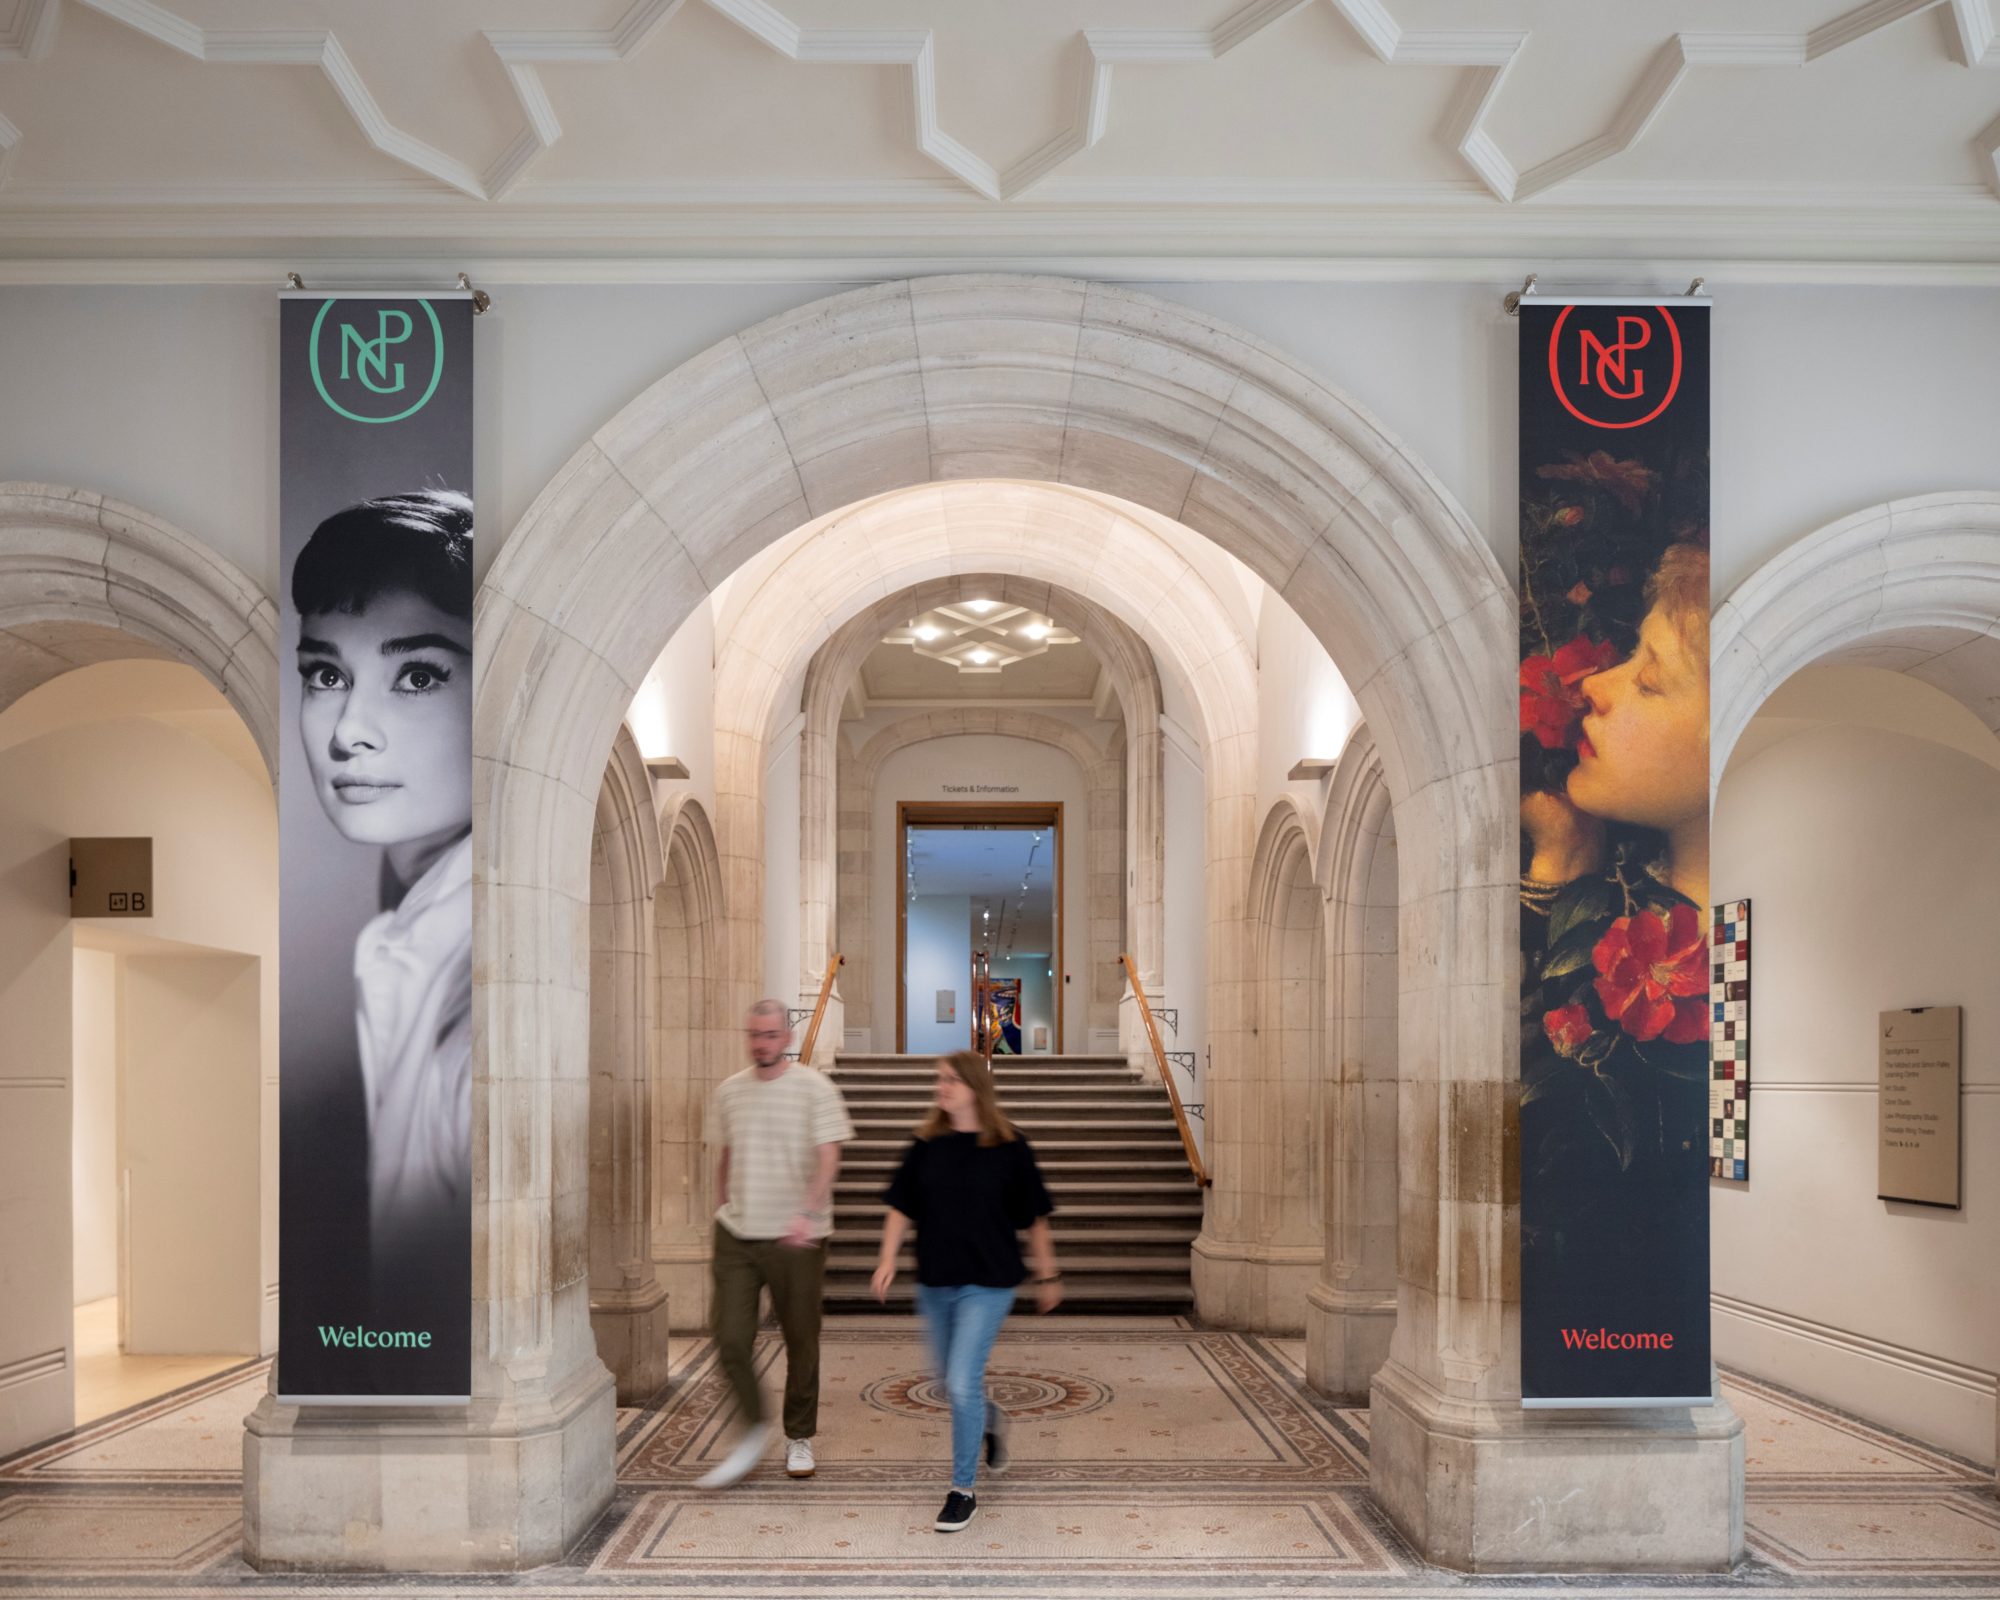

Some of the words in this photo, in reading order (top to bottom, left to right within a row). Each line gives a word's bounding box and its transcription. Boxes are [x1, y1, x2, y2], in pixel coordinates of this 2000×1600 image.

[942, 785, 968, 793] Tickets
[969, 785, 975, 793] &
[976, 785, 1019, 793] Information
[132, 892, 146, 911] B
[317, 1325, 432, 1348] Welcome
[1561, 1327, 1673, 1350] Welcome
